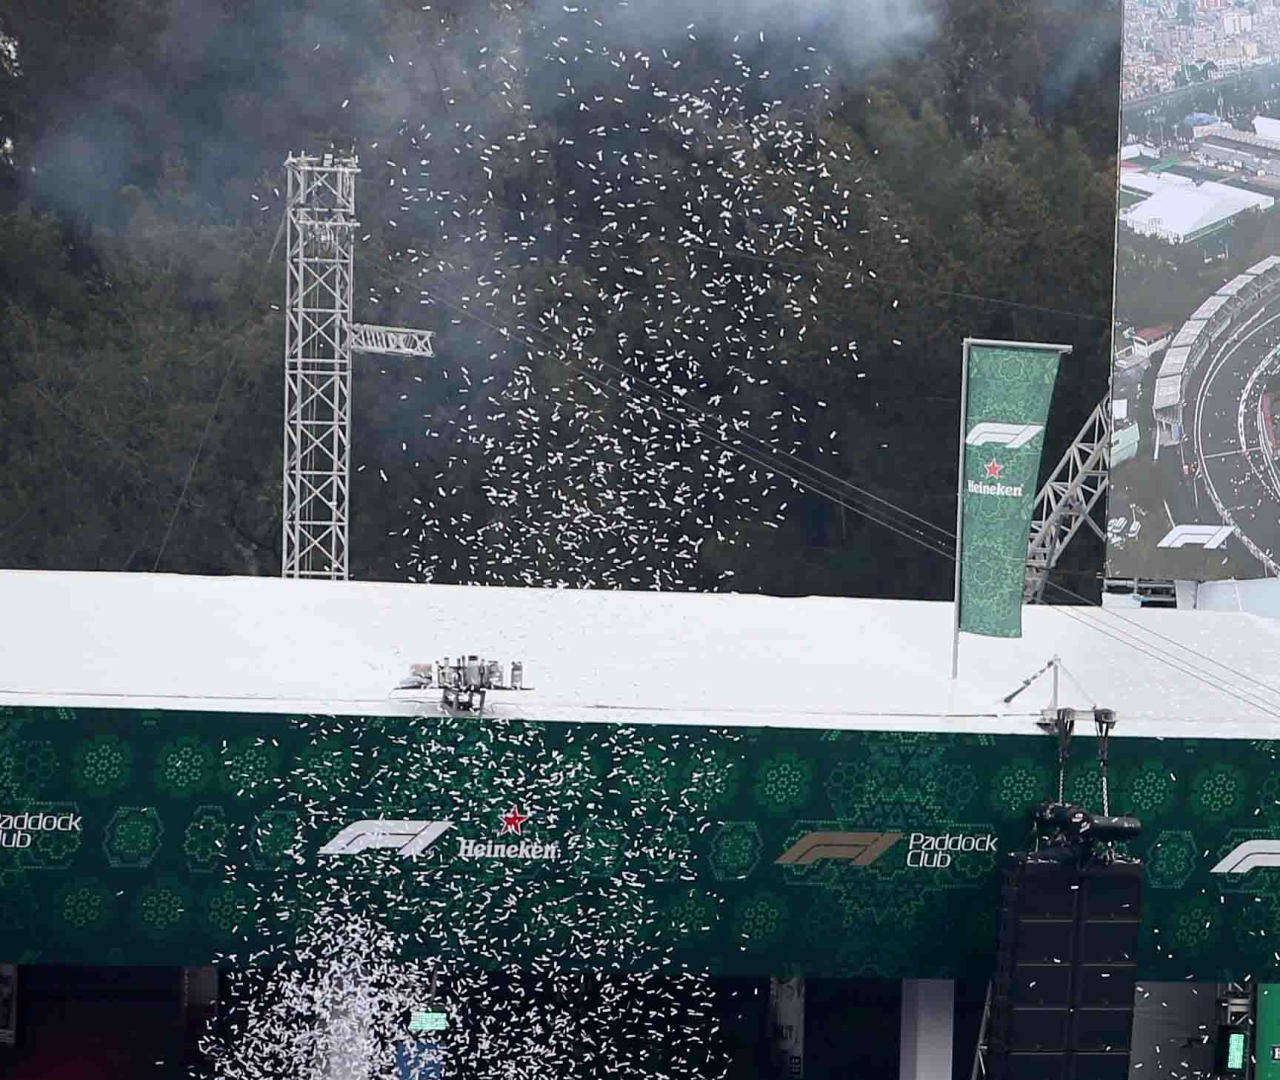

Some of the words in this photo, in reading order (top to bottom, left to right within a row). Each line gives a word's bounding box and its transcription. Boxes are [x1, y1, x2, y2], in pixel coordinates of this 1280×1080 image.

[968, 479, 1022, 497] Heineken
[0, 831, 32, 848] lub
[908, 833, 998, 852] Paddock
[458, 838, 558, 860] Heineken
[906, 850, 951, 868] Club
